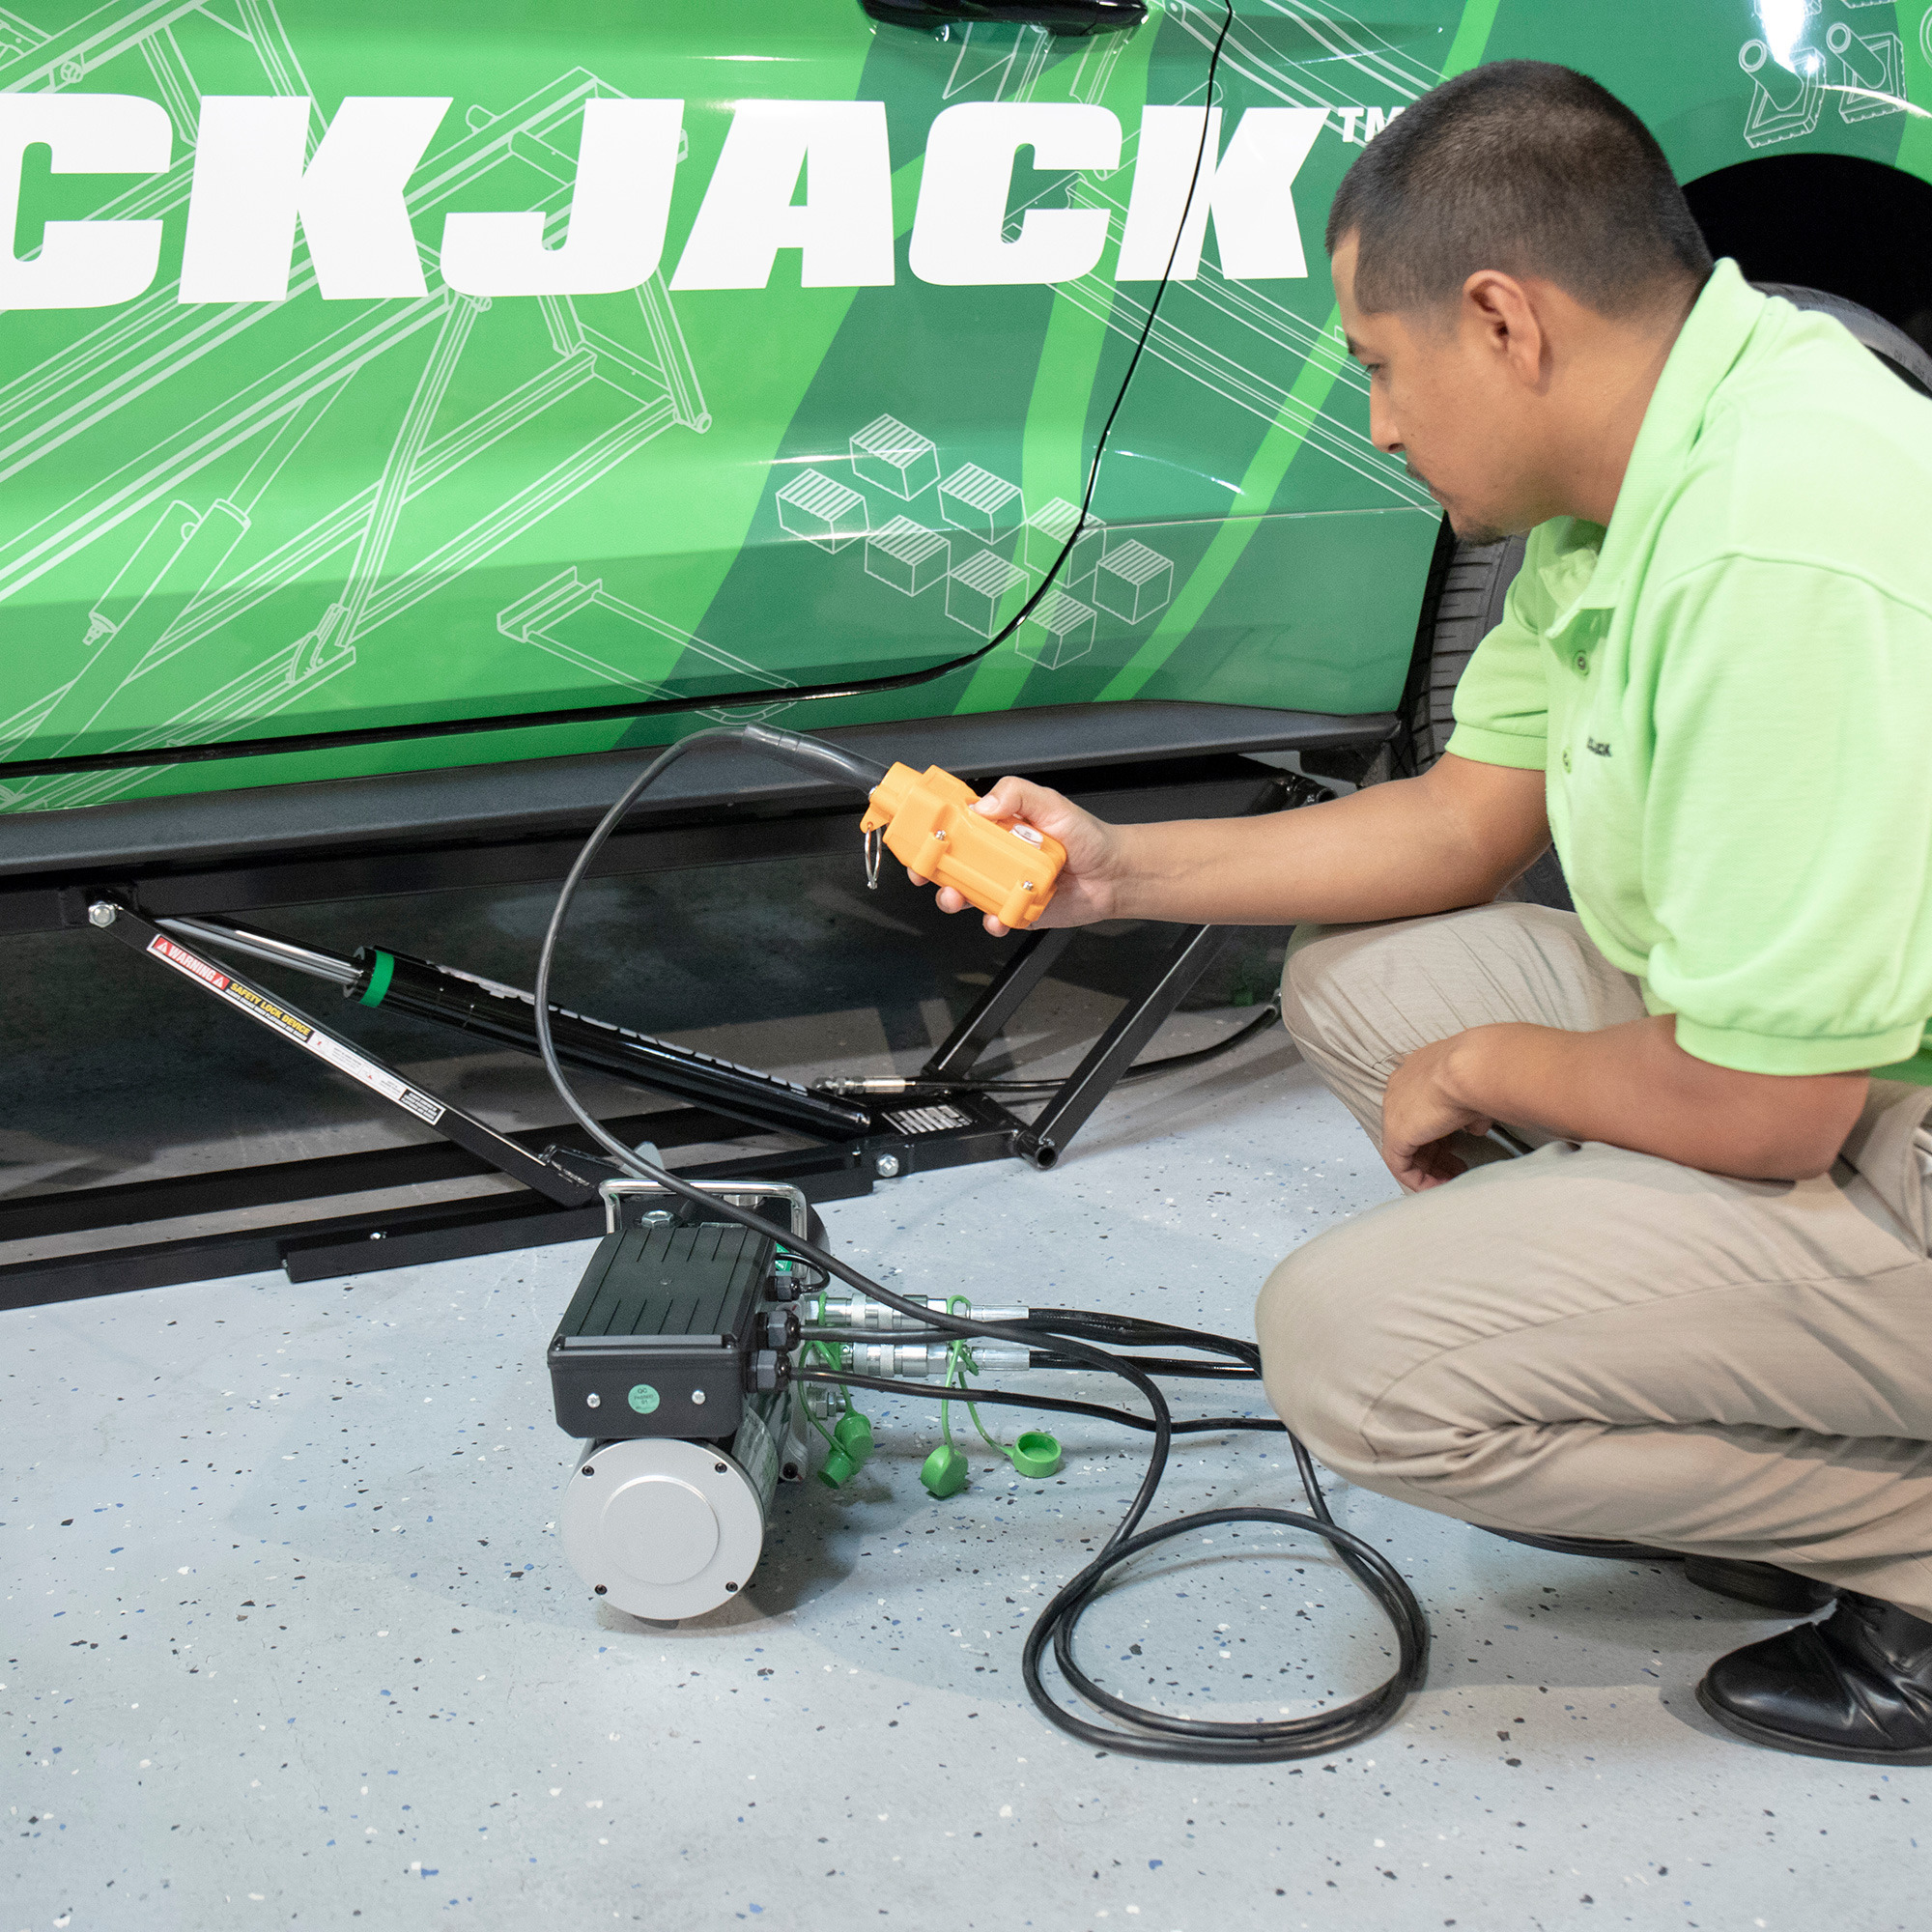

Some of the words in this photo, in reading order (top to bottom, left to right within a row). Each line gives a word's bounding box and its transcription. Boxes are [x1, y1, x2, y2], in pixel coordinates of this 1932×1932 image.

[167, 945, 216, 981] WARNING
[230, 982, 262, 1005] SAFETY
[260, 1001, 283, 1018] LOCK
[281, 1014, 311, 1036] DEVICE
